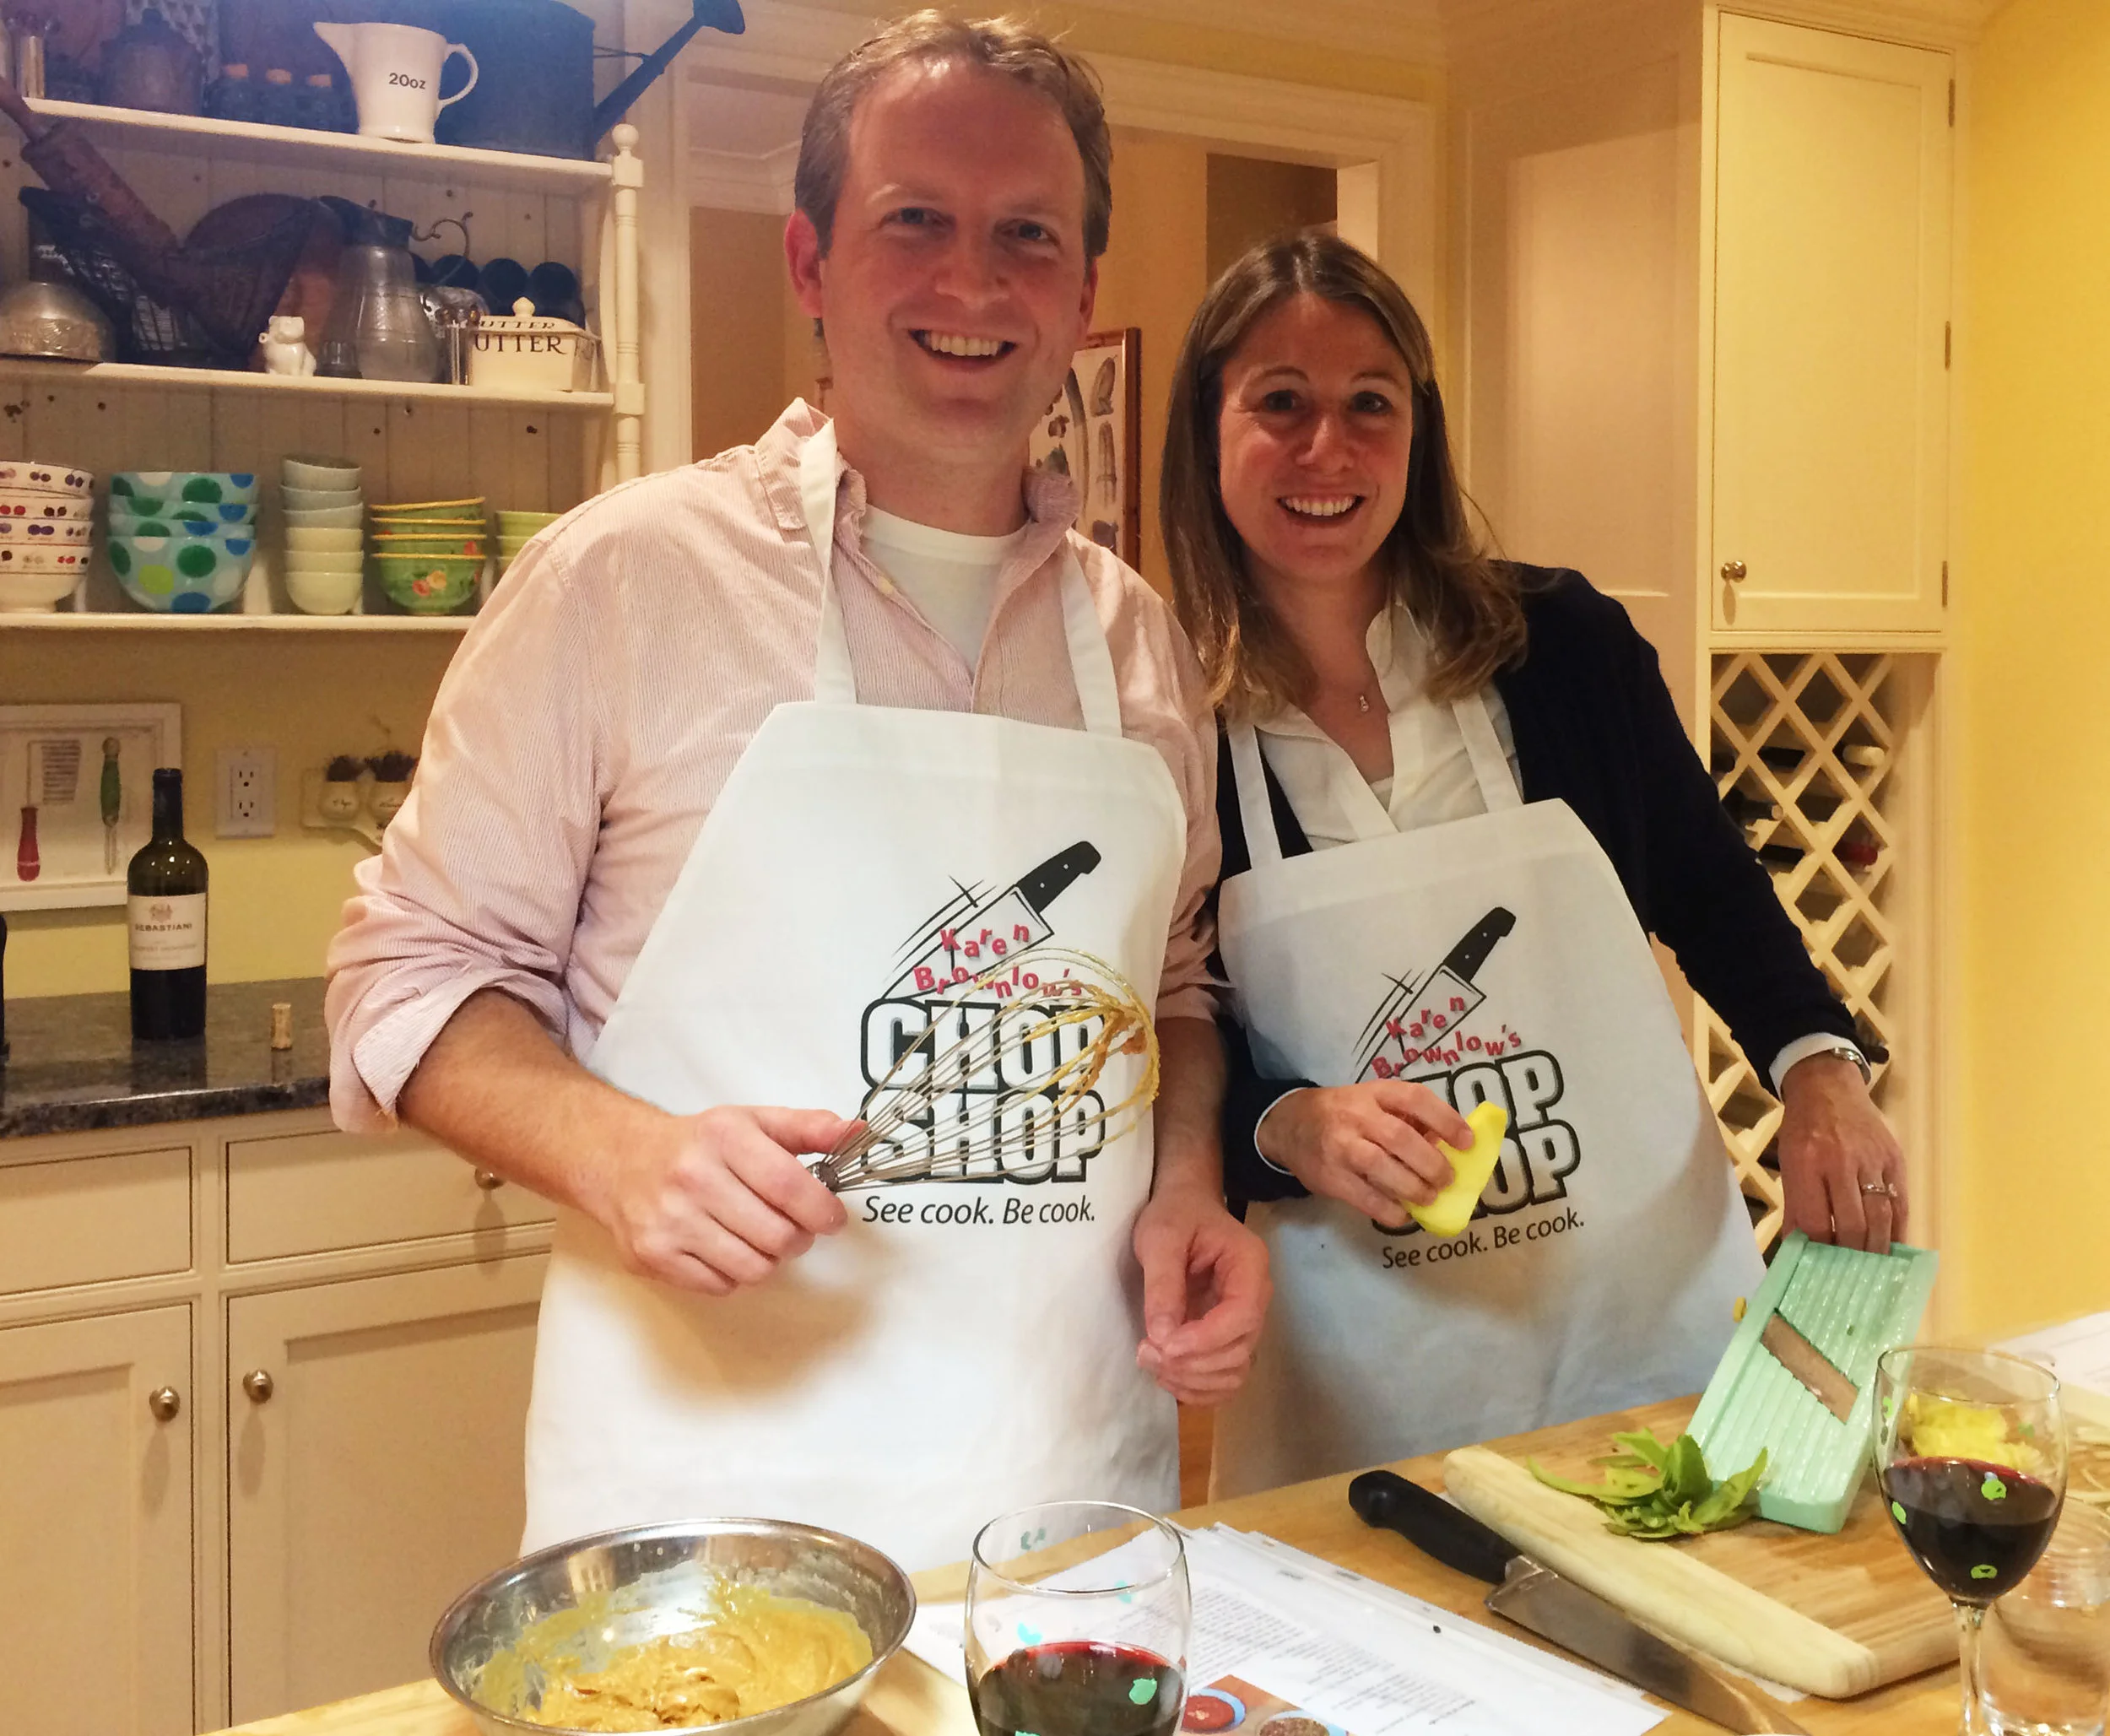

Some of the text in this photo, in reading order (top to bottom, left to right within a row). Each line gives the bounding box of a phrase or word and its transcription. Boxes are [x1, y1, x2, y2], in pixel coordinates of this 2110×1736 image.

[389, 73, 426, 89] 20oz
[473, 333, 567, 354] UTTER
[479, 320, 555, 329] UTTER
[939, 924, 1030, 958] Karen
[1385, 996, 1465, 1040] Karen
[861, 998, 1106, 1090] CHOP
[1372, 1024, 1522, 1079] Brownlow's
[1401, 1050, 1565, 1136] OP
[861, 1087, 1106, 1185] SHOP
[862, 1194, 1096, 1225] See cook. Be cook.
[1382, 1207, 1585, 1269] See cook. Be cook.
